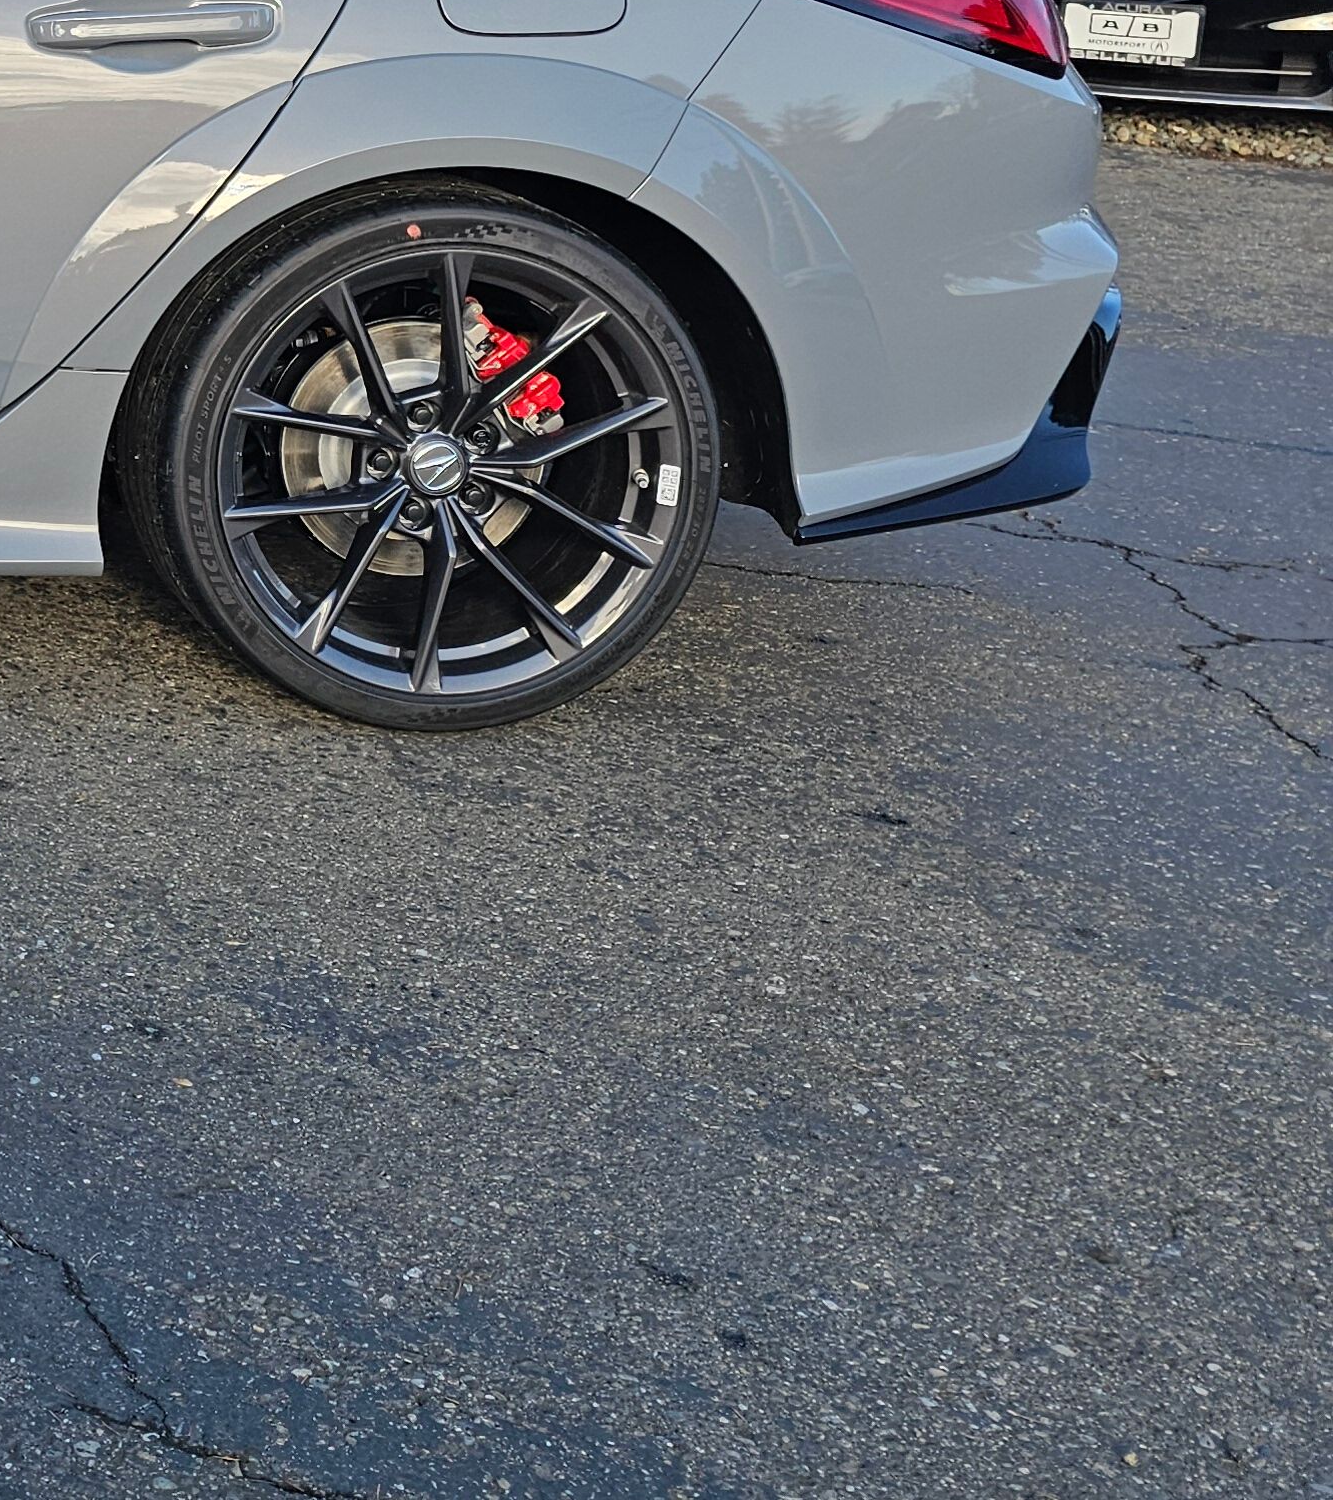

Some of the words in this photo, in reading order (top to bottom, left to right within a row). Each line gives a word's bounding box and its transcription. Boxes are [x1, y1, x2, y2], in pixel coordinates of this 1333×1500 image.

[1101, 2, 1166, 15] ACURA
[1102, 20, 1119, 30] A
[1142, 23, 1159, 32] B
[1069, 48, 1186, 67] BELLEVUE
[1088, 39, 1146, 48] MOTORSPORT
[202, 373, 223, 419] SPORT
[666, 341, 712, 474] MICHELIN
[191, 423, 207, 464] PILOT
[187, 474, 237, 606] MICHELIN
